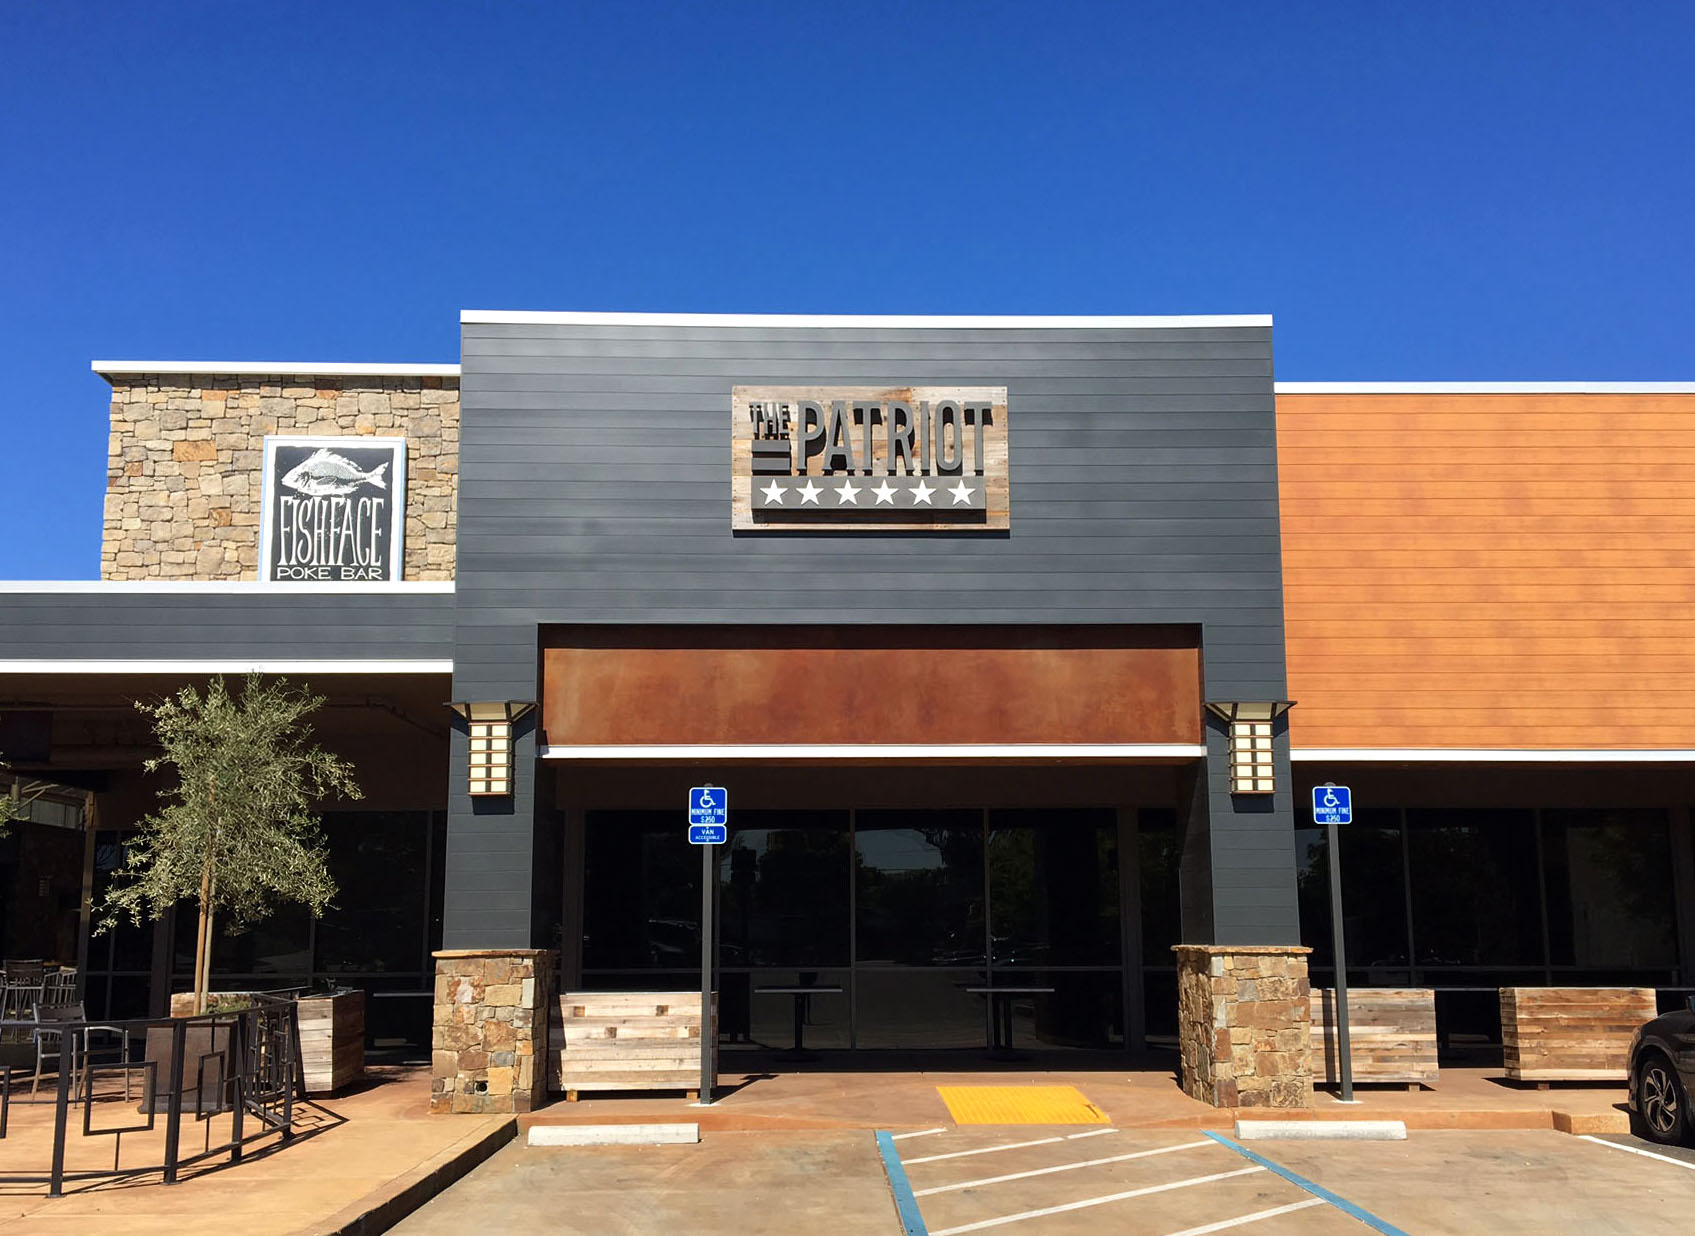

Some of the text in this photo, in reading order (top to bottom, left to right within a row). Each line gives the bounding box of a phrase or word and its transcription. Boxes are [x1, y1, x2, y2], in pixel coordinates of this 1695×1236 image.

[750, 400, 992, 471] THE PATRIOT
[277, 496, 384, 566] FISHFACE
[277, 567, 383, 580] POKE BAR
[700, 815, 715, 823] $250
